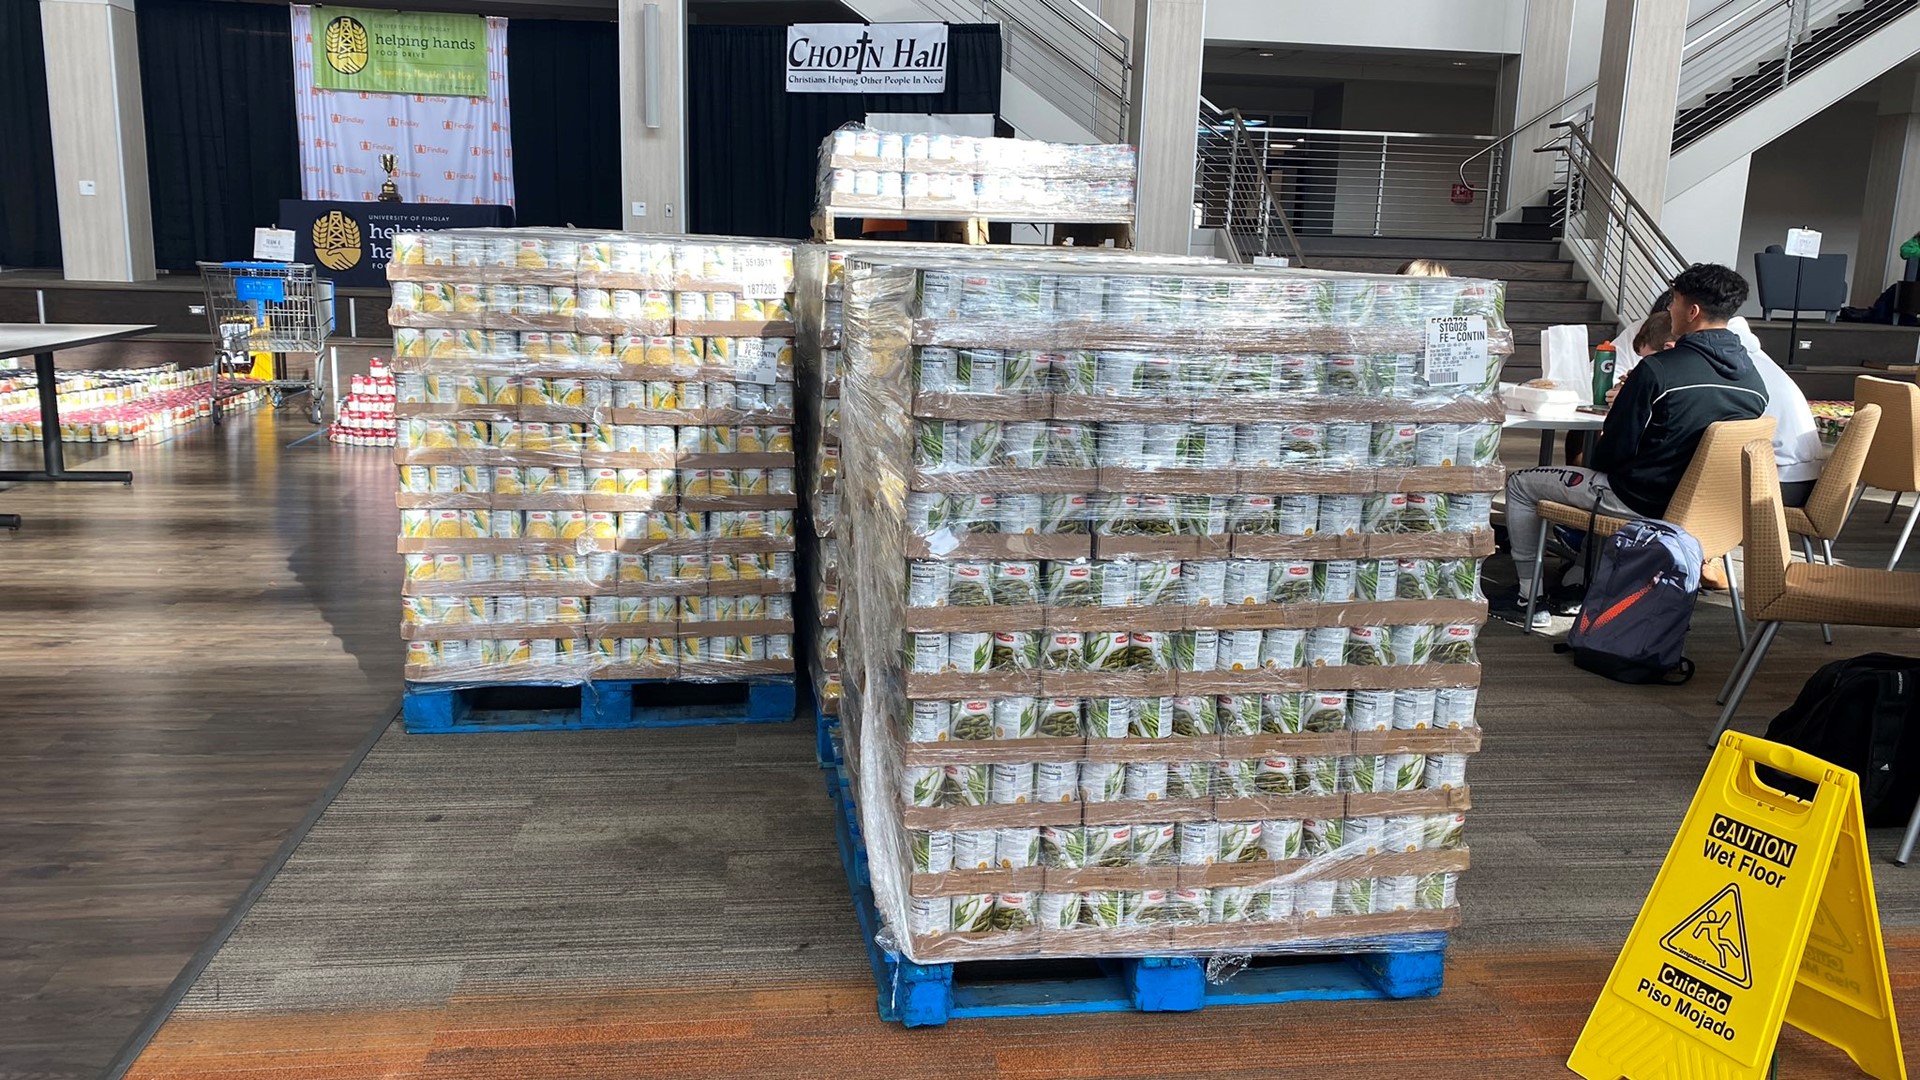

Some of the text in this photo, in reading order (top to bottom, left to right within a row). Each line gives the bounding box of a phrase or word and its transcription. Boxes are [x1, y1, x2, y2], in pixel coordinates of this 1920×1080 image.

[375, 34, 476, 50] helping hands
[892, 38, 946, 68] Hall
[788, 75, 943, 86] Christians Helping Other People In Need
[748, 284, 776, 294] 1877205
[1440, 322, 1467, 332] STG028
[1713, 817, 1794, 865] CAUTION
[1704, 839, 1786, 888] Wet Floor
[1679, 948, 1707, 964] impact
[1661, 967, 1728, 1012] Cuidado
[1637, 978, 1735, 1040] Piso Mojado
